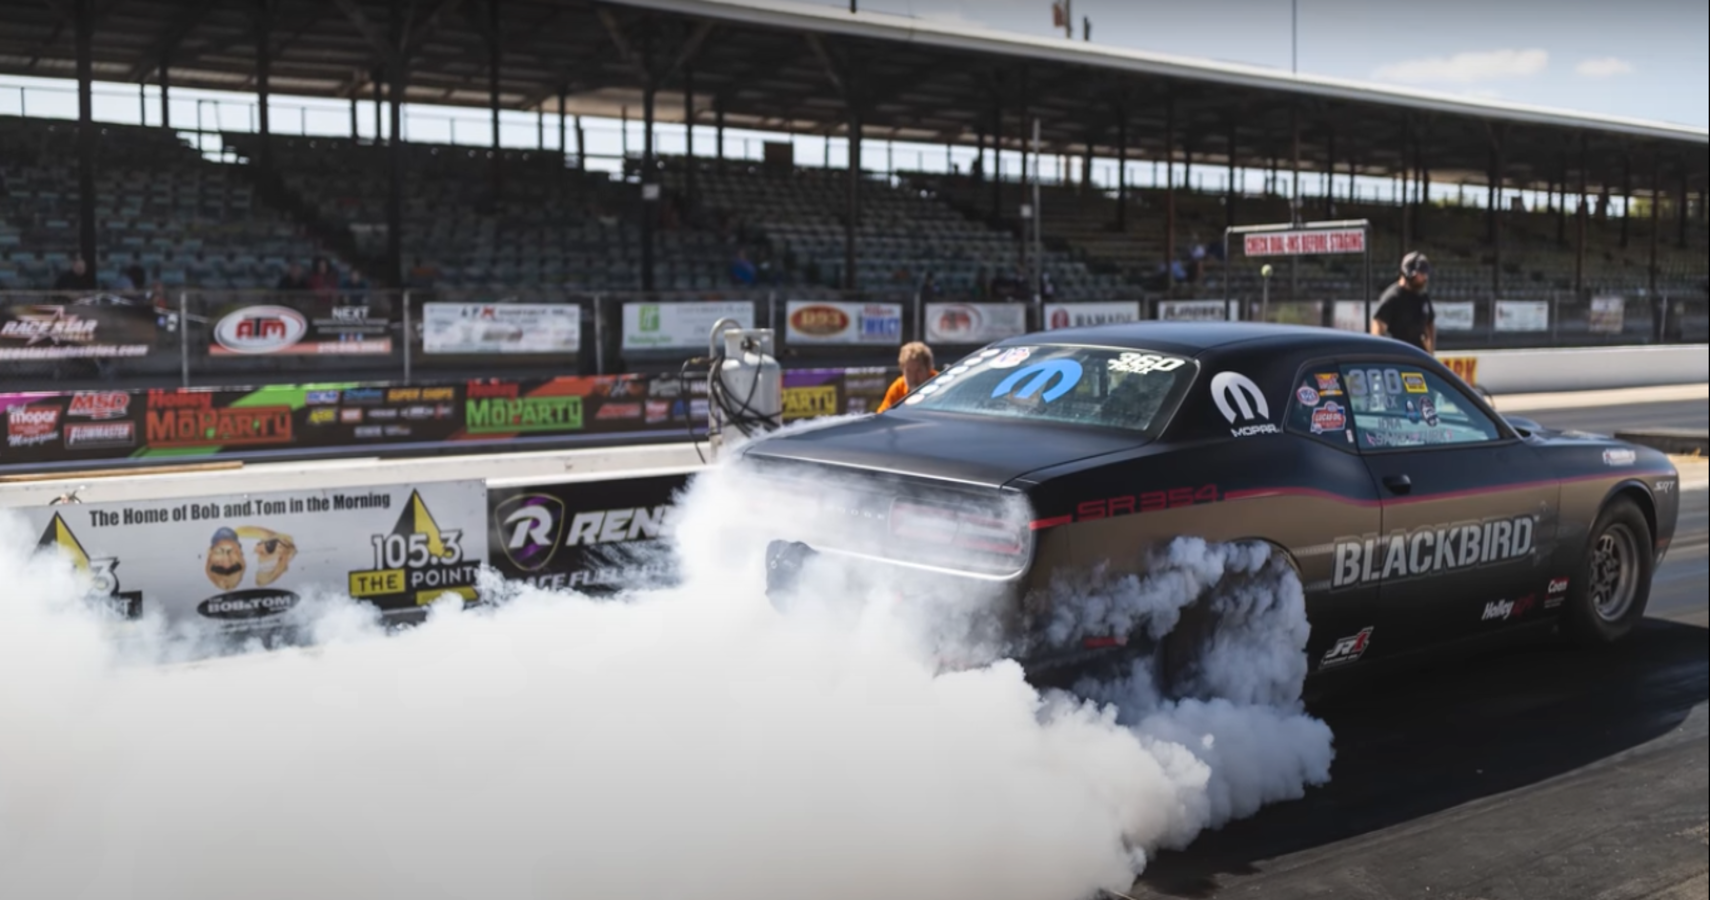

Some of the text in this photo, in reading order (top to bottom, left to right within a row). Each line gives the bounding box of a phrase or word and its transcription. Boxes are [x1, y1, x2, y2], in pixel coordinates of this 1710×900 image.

[1, 320, 50, 336] RACE
[1120, 352, 1186, 371] 360
[70, 391, 130, 412] MSD
[147, 388, 213, 412] Holley
[1231, 423, 1278, 438] MOPAR
[1654, 480, 1676, 494] SRT
[89, 493, 391, 528] The Home of Bob and Tom in the Morning
[371, 529, 464, 571] 105.3
[1333, 514, 1535, 588] BLACKBIRD
[357, 565, 474, 593] THE POINT
[1481, 599, 1515, 621] Holley
